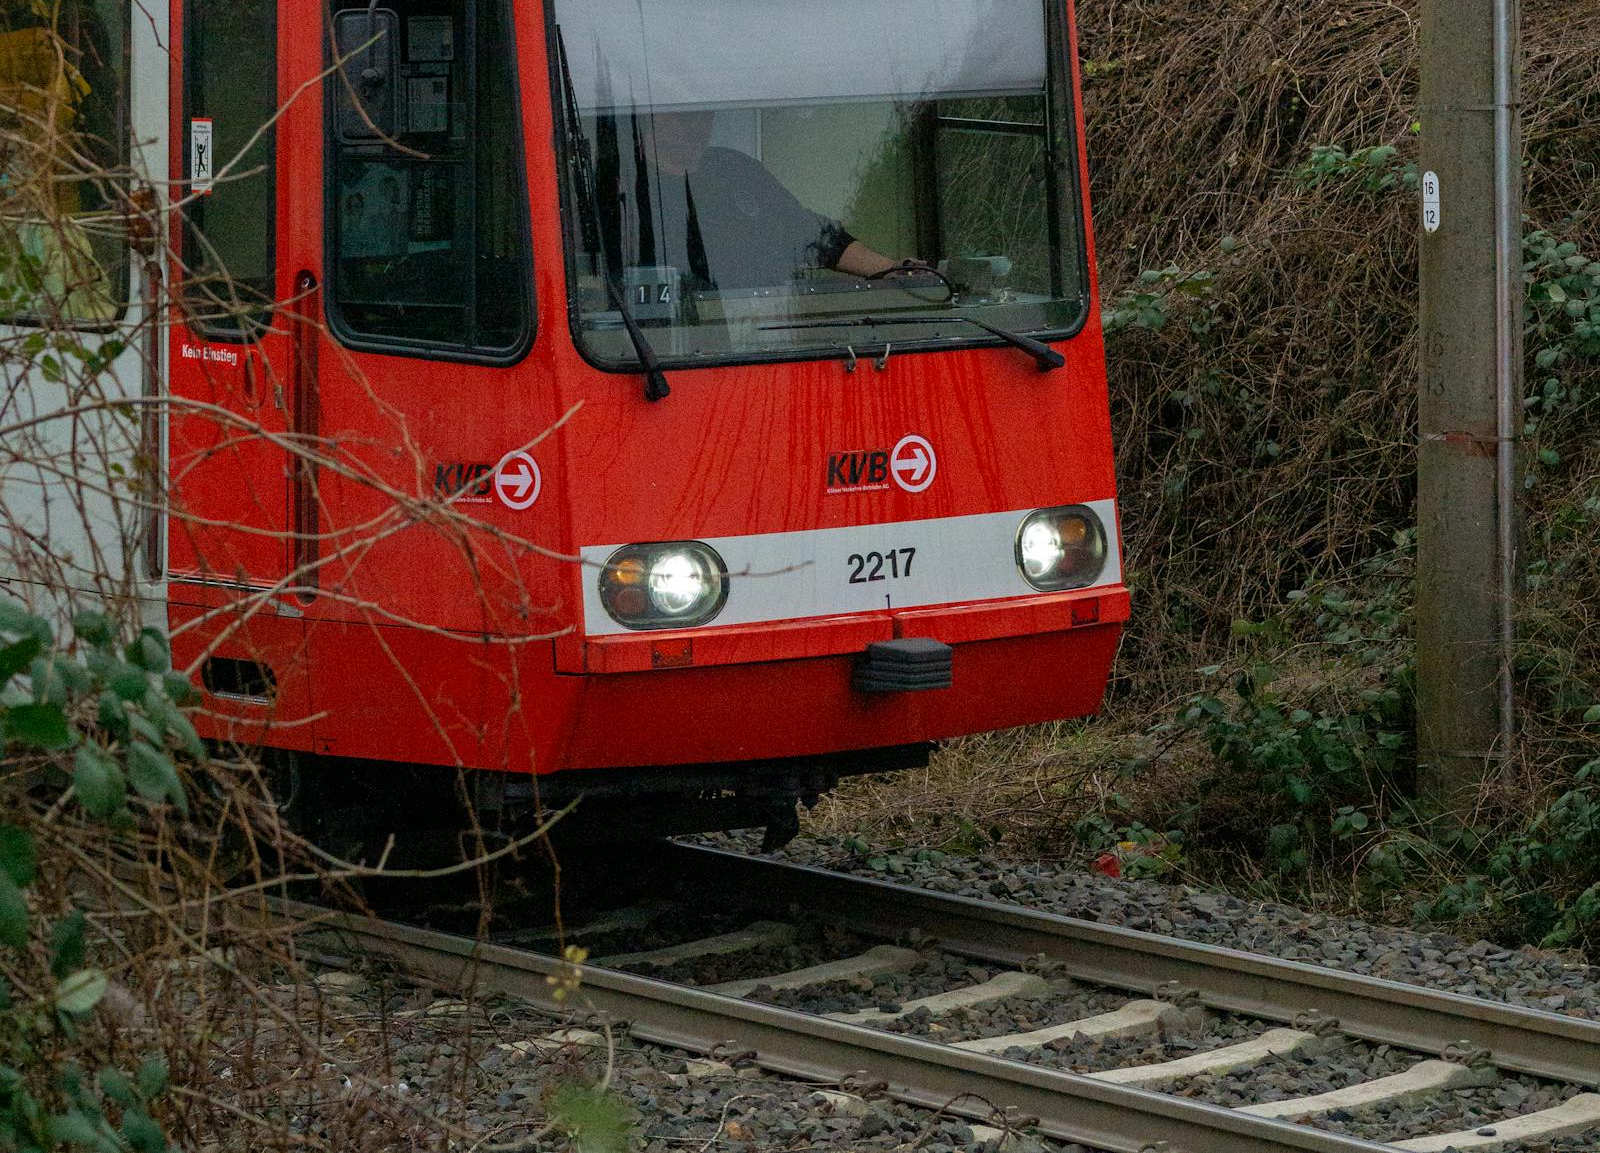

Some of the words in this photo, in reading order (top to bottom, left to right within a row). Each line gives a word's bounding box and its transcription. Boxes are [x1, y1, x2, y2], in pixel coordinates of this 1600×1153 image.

[1425, 181, 1434, 195] 16
[1425, 210, 1435, 224] 12
[182, 344, 201, 359] Kein
[203, 346, 237, 366] Einstieg
[434, 462, 492, 496] KVB
[827, 451, 888, 487] KVB
[847, 547, 916, 584] 2217
